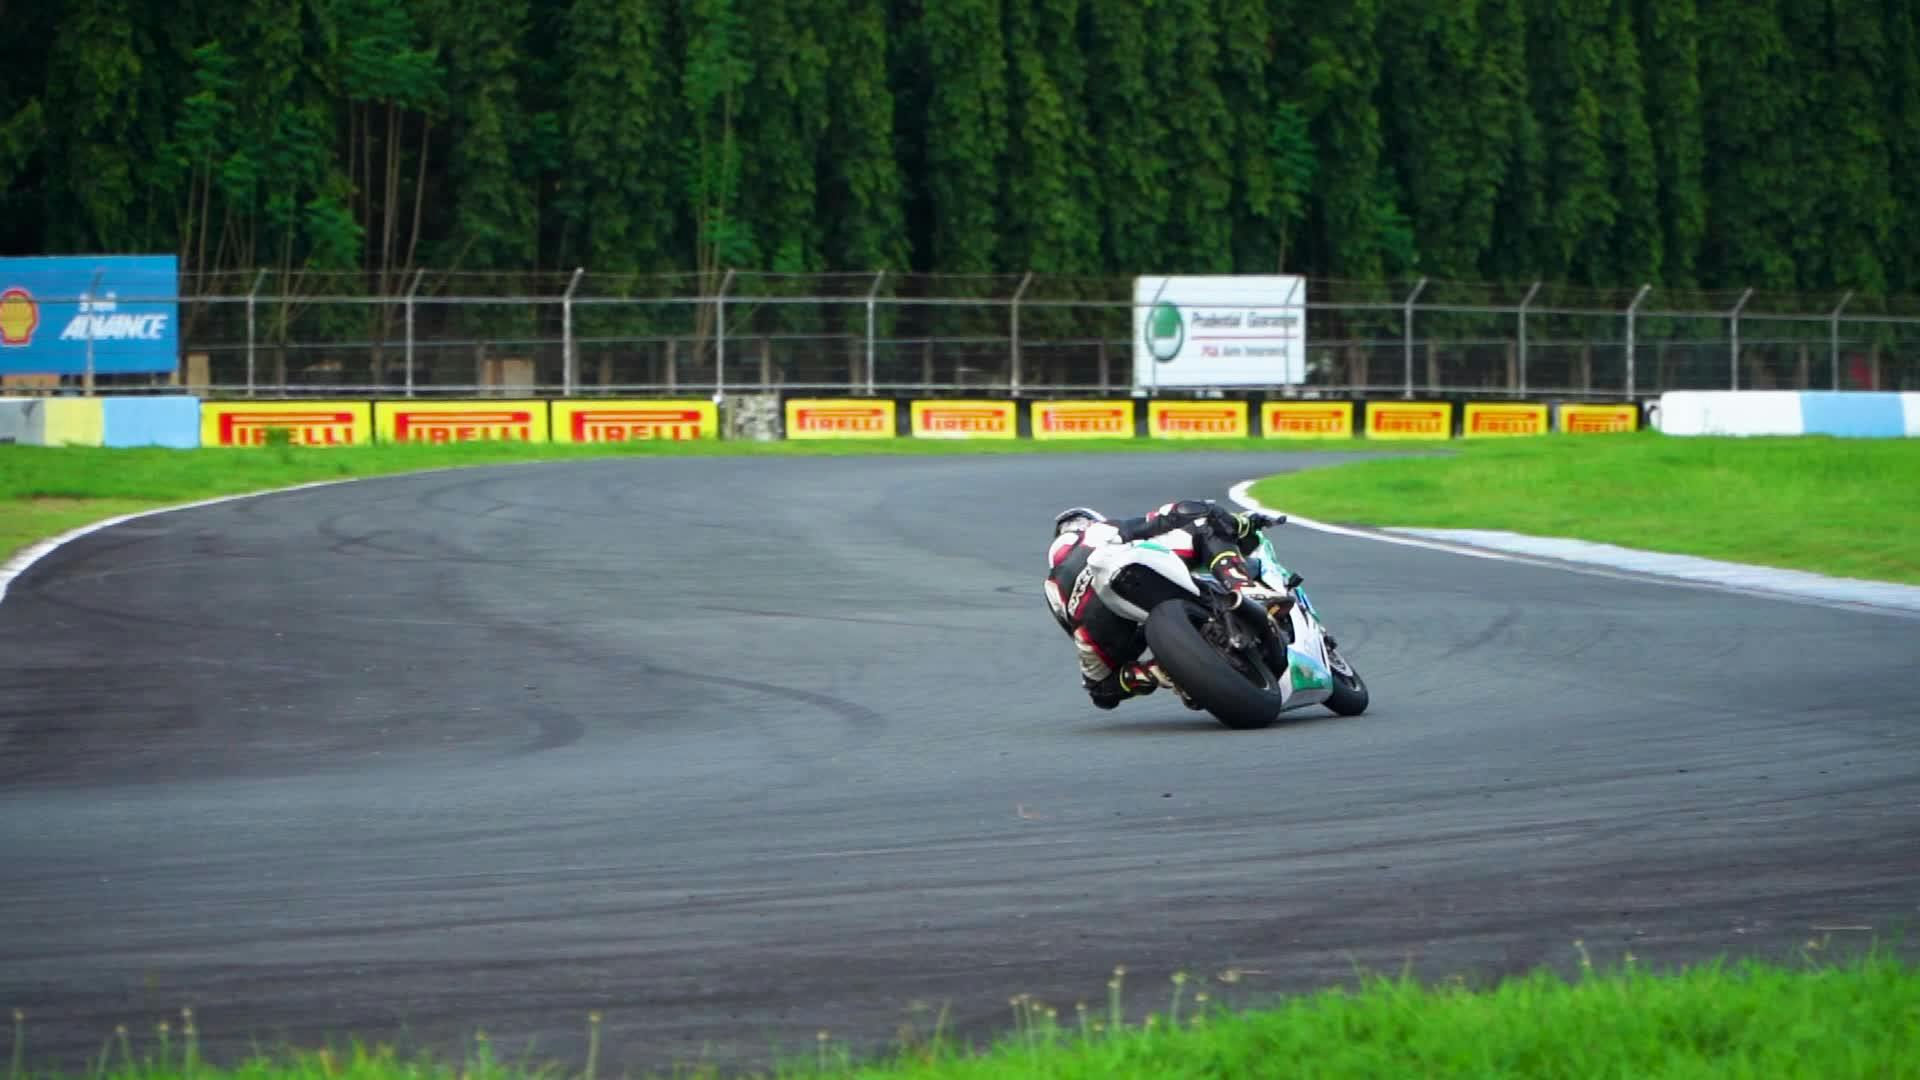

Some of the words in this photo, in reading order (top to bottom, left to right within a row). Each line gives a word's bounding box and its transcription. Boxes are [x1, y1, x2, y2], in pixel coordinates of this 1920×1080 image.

[59, 313, 168, 340] ADVANCE
[796, 408, 884, 431] PIRELLI
[922, 409, 1005, 432] PIRELLI
[1042, 409, 1124, 432] PIRELLI
[1159, 409, 1238, 433] PIRELLI
[1272, 410, 1344, 433] PIRELLI
[1374, 411, 1442, 433] PIRELLI
[1472, 411, 1538, 433] PIRELLI
